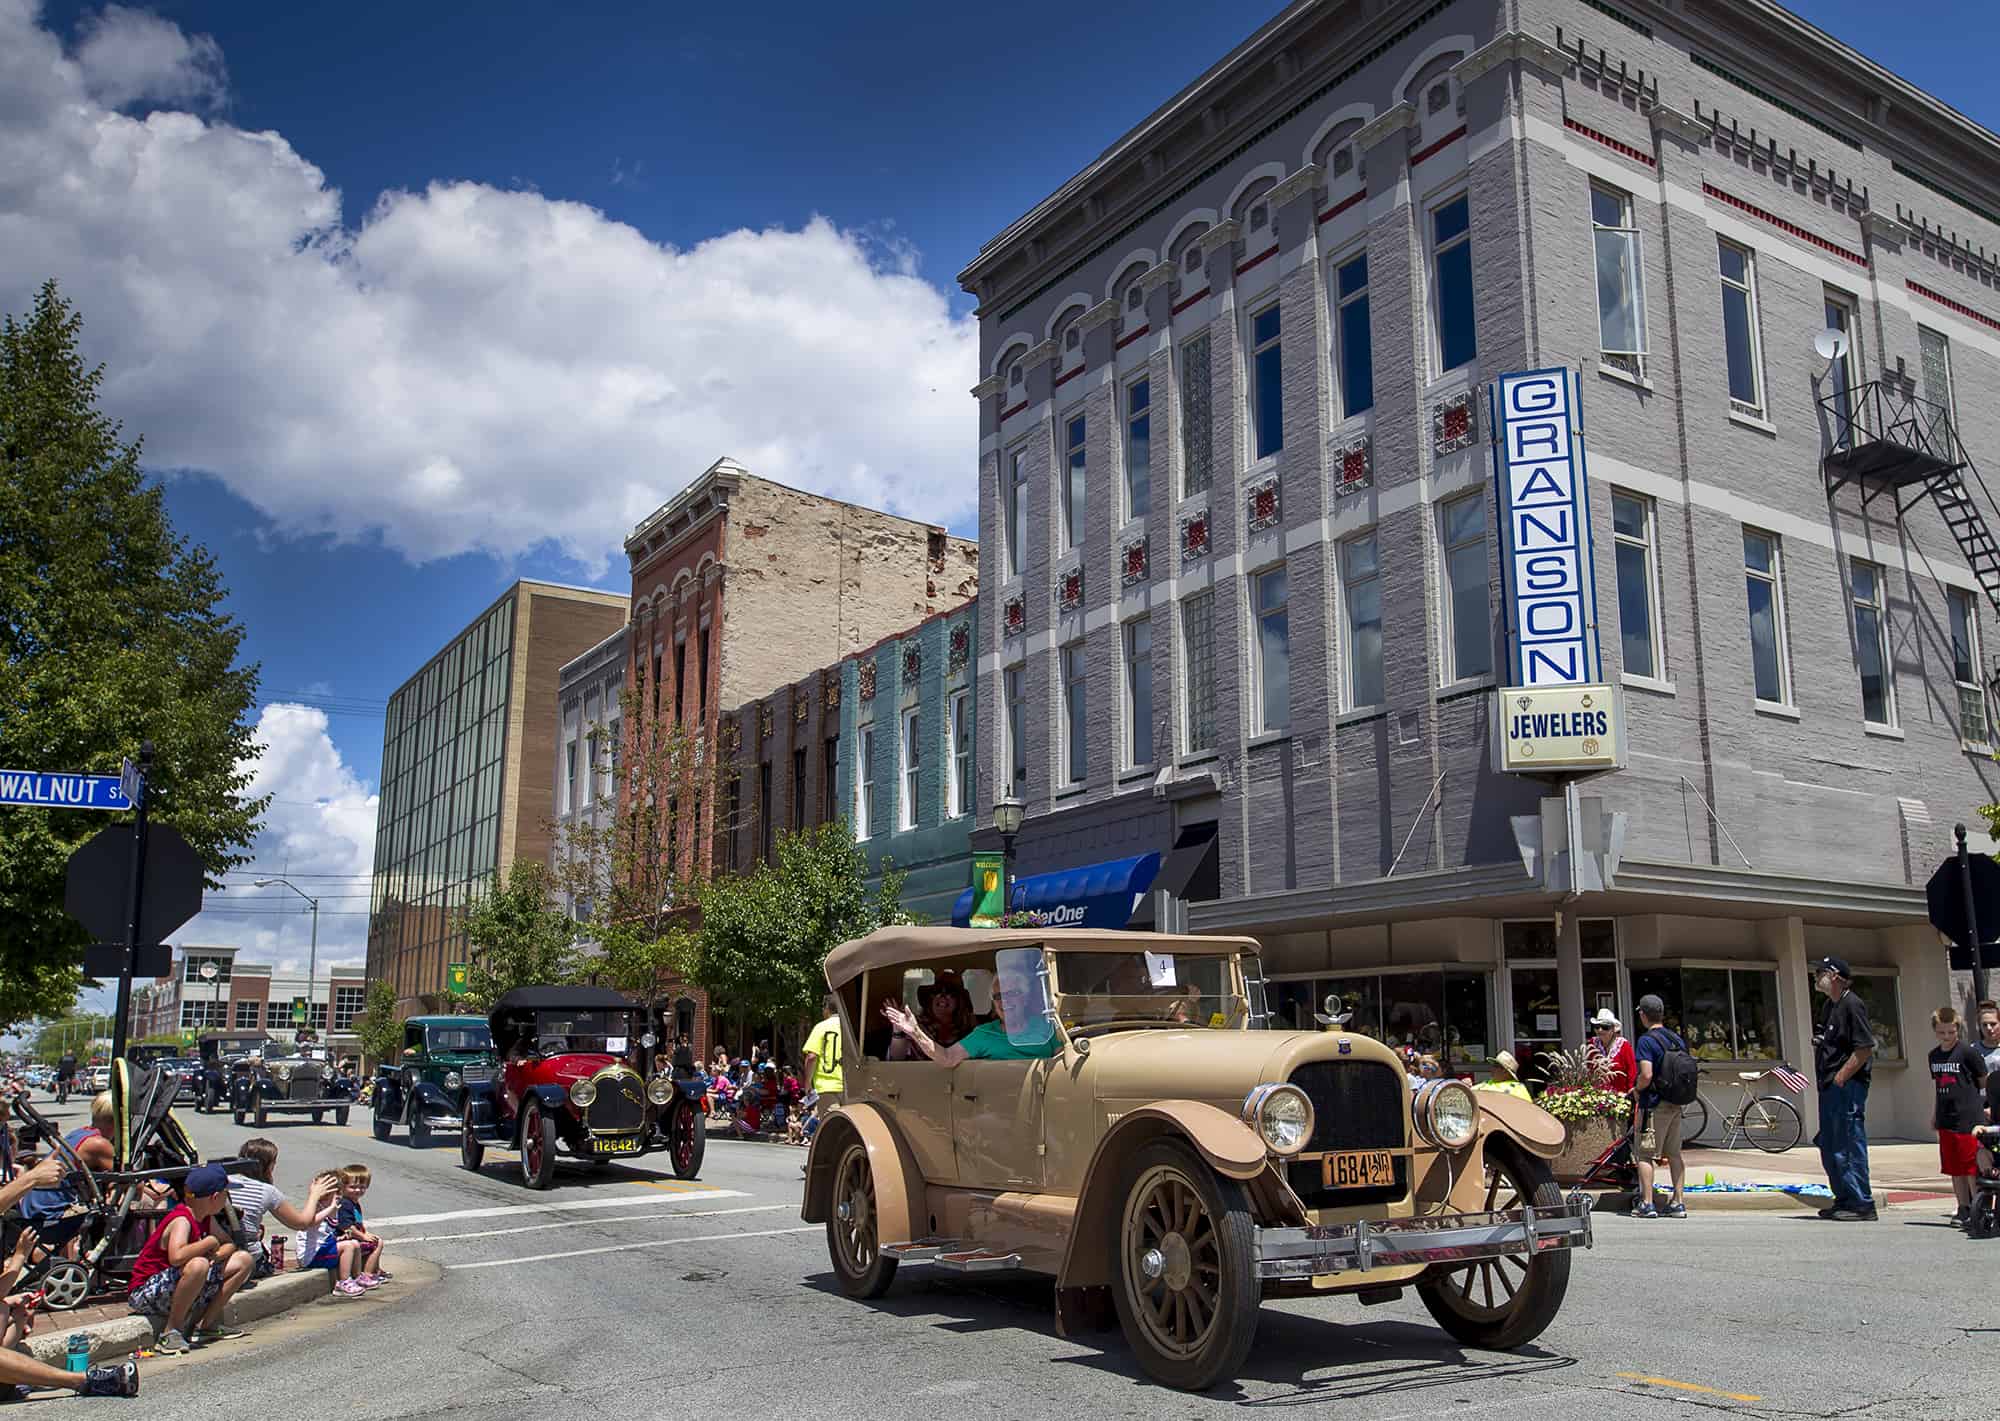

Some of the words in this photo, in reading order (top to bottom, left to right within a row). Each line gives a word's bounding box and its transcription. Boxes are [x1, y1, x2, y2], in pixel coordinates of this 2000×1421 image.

[1511, 379, 1577, 683] GRANSON
[1510, 710, 1608, 739] JEWELERS
[0, 774, 99, 804] WALNUT
[1160, 959, 1167, 973] 4
[1328, 1154, 1369, 1185] 1684
